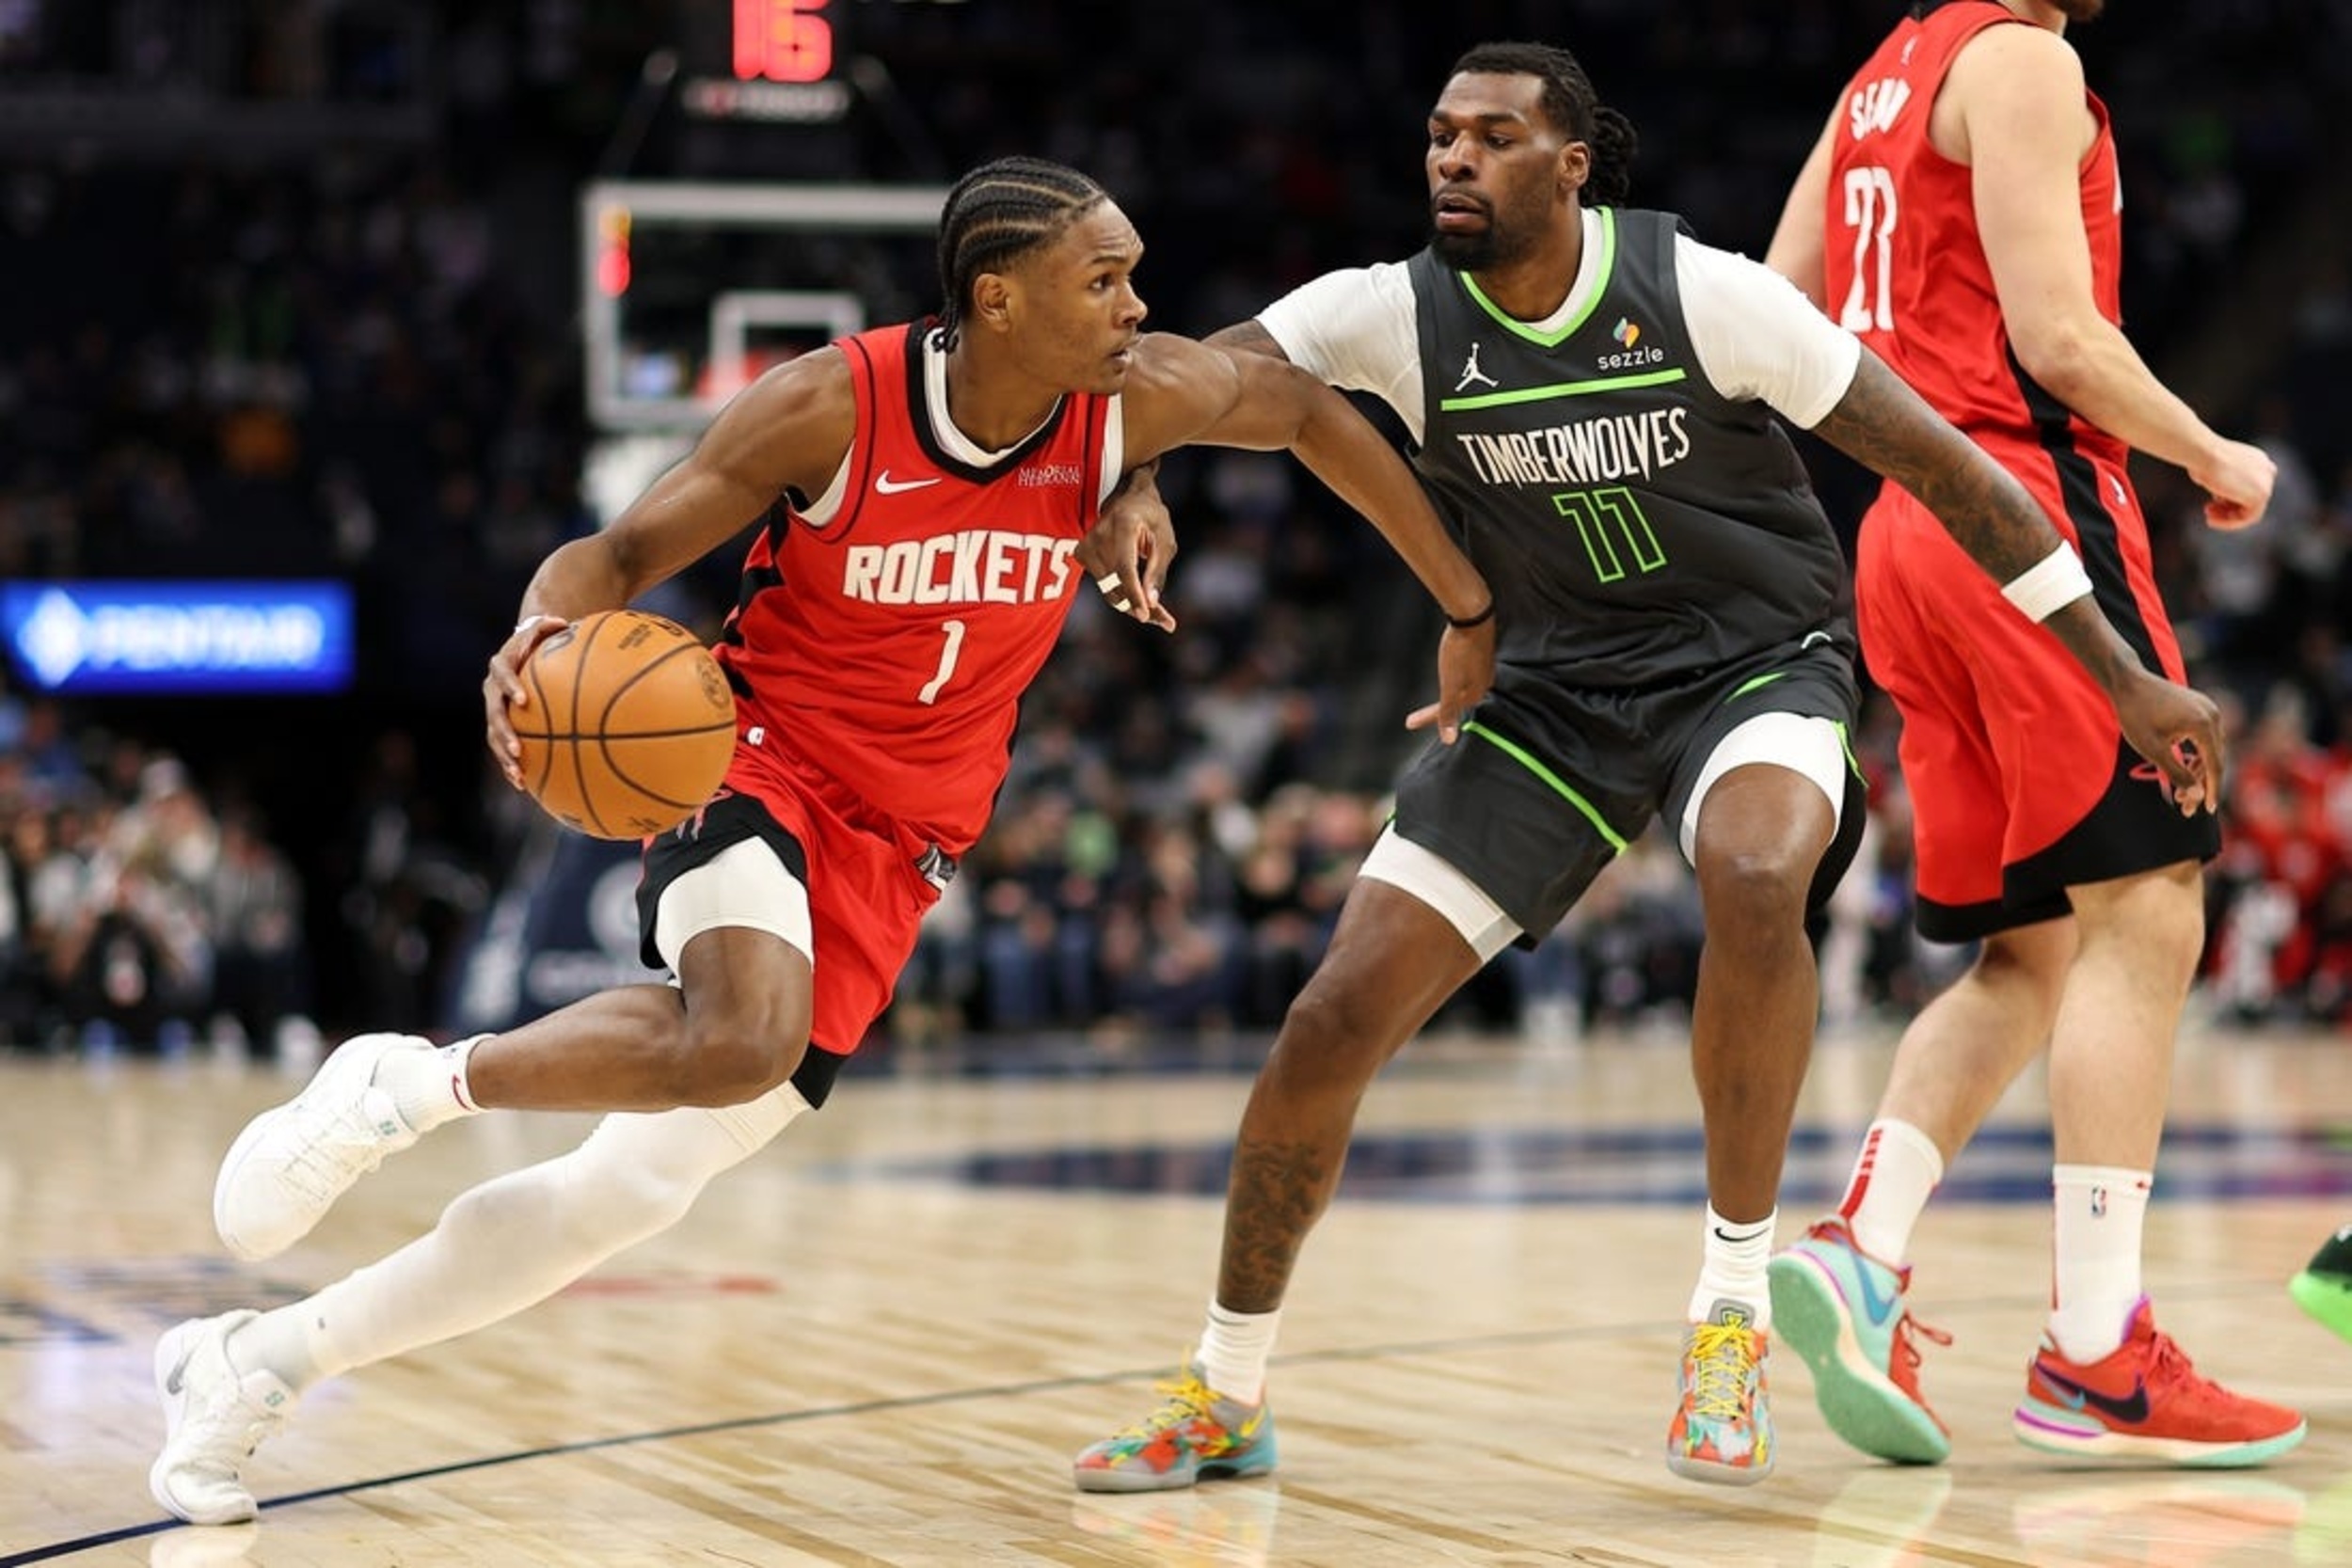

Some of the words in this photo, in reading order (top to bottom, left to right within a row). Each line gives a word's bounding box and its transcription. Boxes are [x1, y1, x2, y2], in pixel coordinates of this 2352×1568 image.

[1598, 346, 1663, 370] sezzle
[1457, 407, 1691, 490] TIMBERWOLVES
[843, 530, 1079, 605] ROCKETS
[1552, 486, 1667, 583] 11
[917, 619, 965, 705] 1
